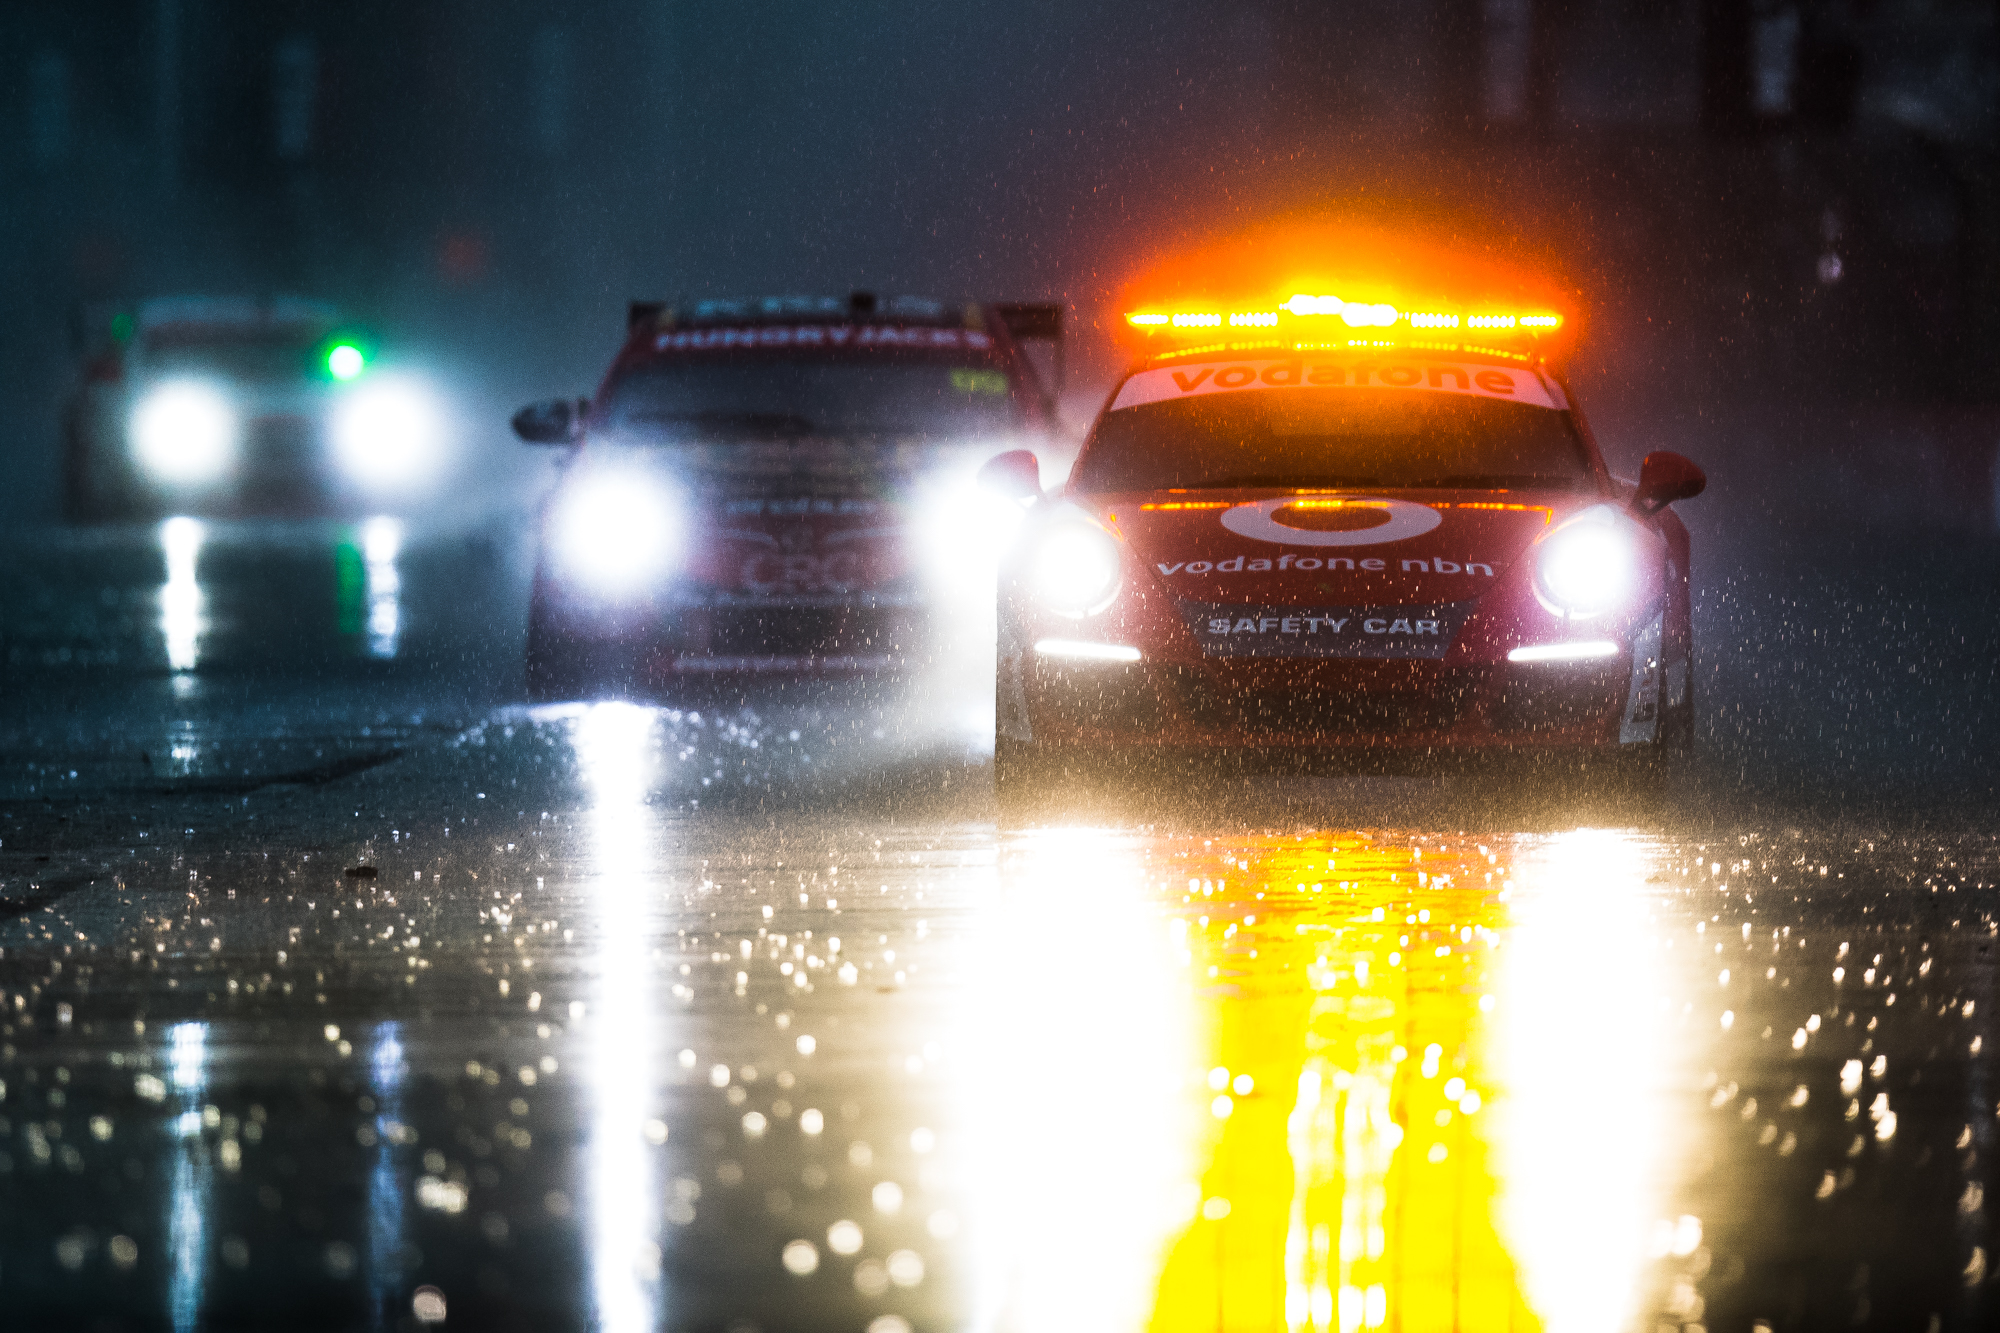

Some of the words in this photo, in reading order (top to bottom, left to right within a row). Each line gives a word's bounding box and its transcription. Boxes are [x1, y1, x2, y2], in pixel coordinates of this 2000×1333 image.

[654, 328, 850, 351] HUNGRY
[1171, 360, 1516, 395] vodafone
[1157, 553, 1386, 576] vodafone
[1402, 557, 1495, 578] nbn
[1207, 617, 1349, 634] SAFETY
[1363, 617, 1440, 636] CAR
